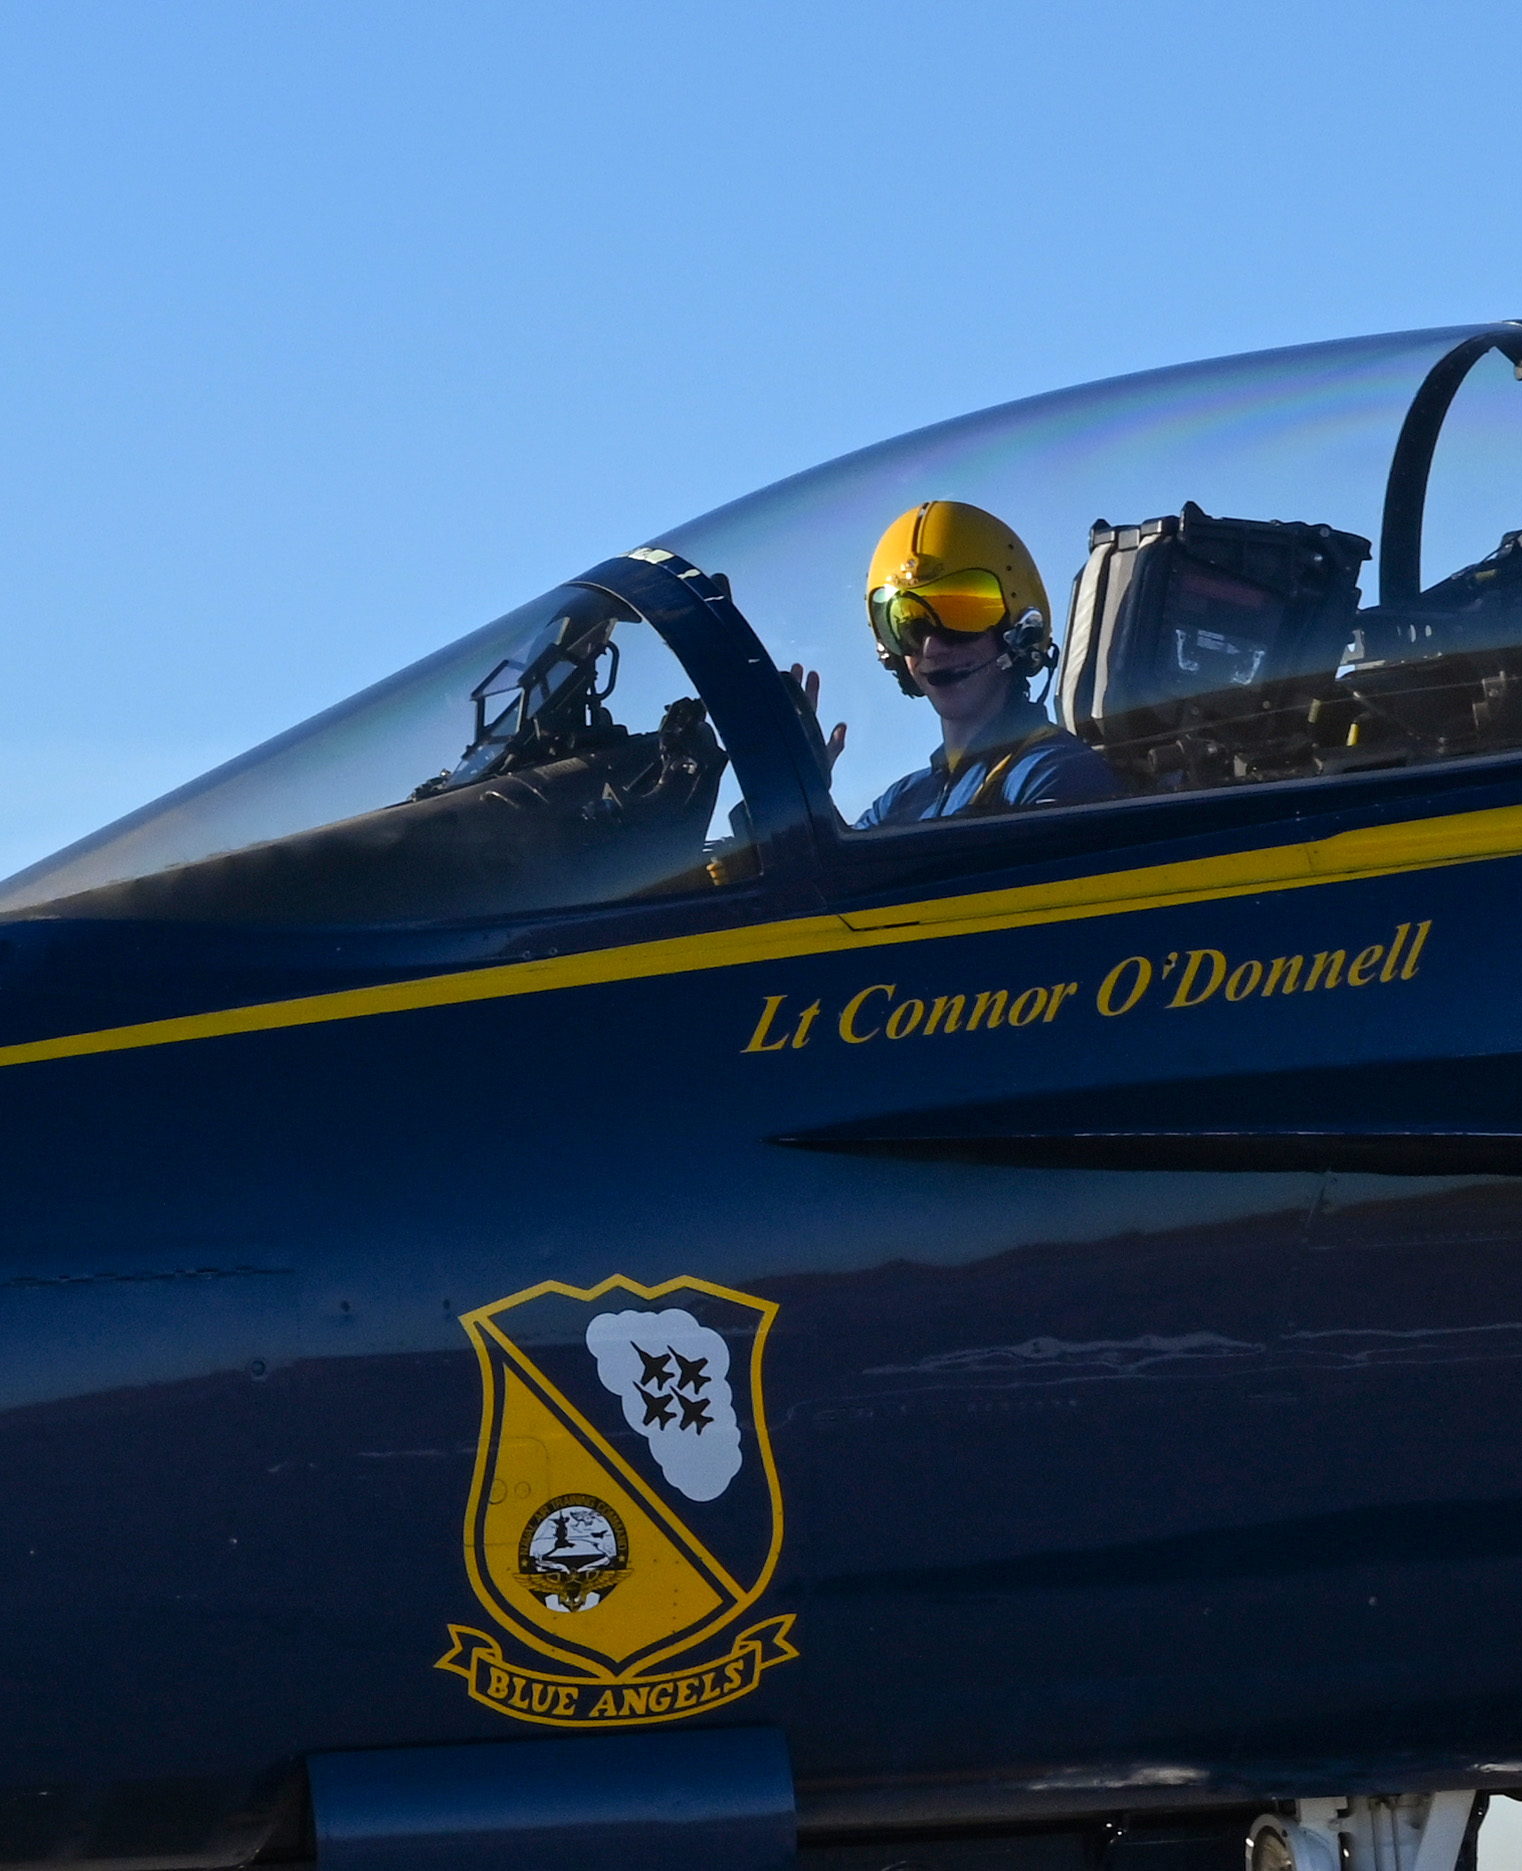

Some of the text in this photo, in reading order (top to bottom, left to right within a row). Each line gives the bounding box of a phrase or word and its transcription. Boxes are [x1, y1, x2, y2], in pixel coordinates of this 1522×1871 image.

[740, 994, 821, 1054] Lt
[838, 981, 1079, 1045] Connor
[519, 1494, 628, 1556] NAVAL AIR TRAINING COMMAND
[488, 1659, 745, 1719] BLUE ANGELS
